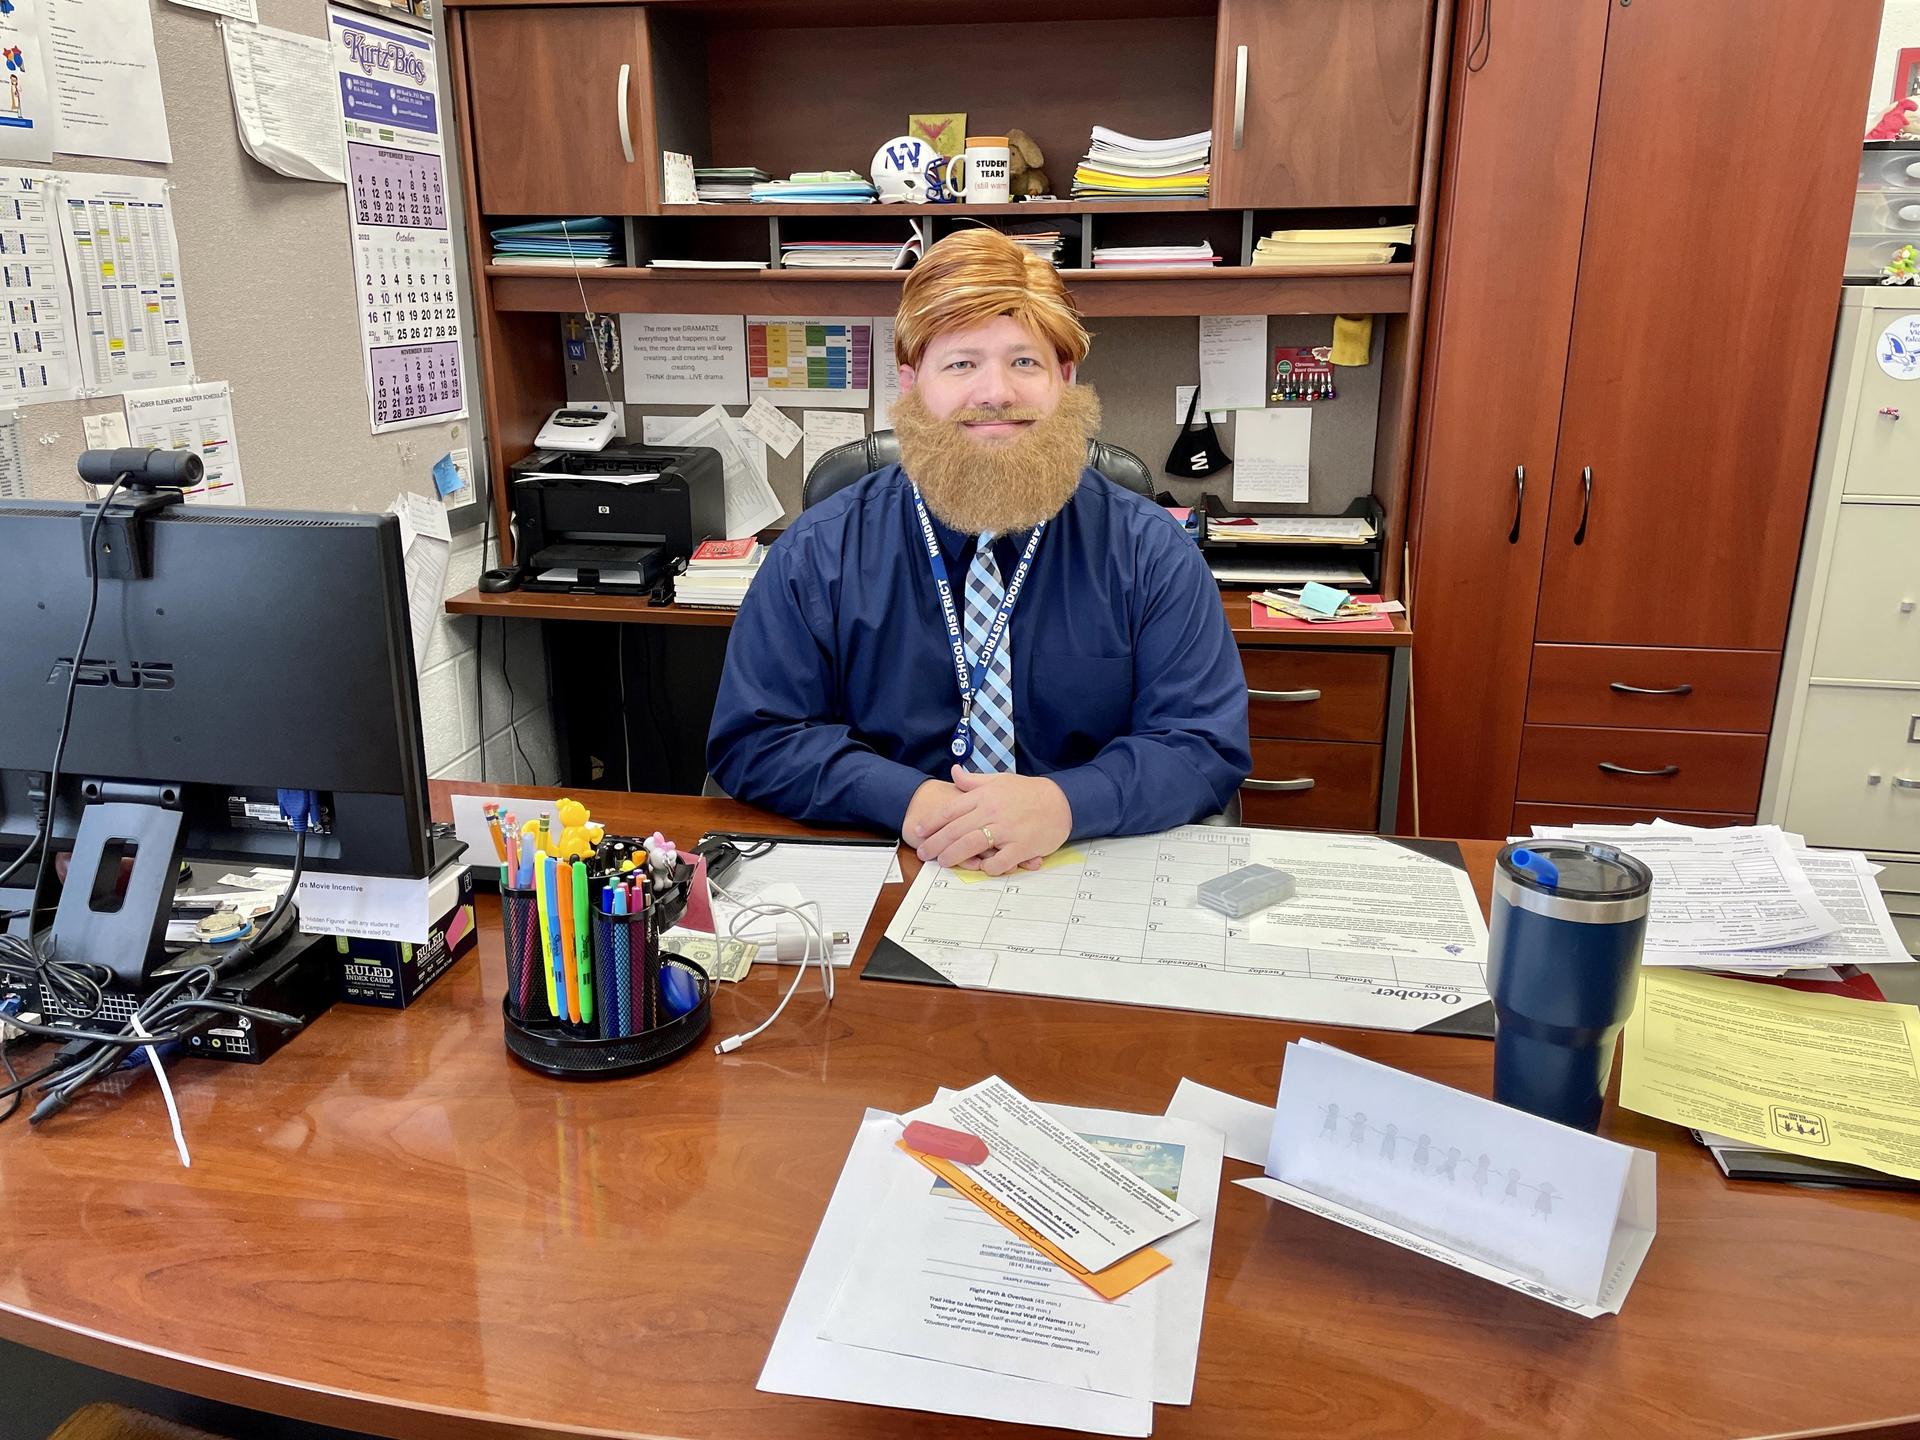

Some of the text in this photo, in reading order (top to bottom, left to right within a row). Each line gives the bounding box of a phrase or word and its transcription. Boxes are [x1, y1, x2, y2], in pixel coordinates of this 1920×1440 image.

[343, 29, 389, 75] Kurtz
[378, 151, 403, 159] SEPTEMBER
[887, 142, 921, 171] W
[976, 160, 1007, 168] STUDENT
[396, 232, 415, 243] October
[444, 257, 447, 267] 1
[366, 274, 450, 286] 2 3 4 5 6 7 8
[368, 292, 453, 304] 9 10 11 12 13 14 15
[368, 308, 455, 323] 16 17 18 19 20 21 22
[397, 326, 457, 340] 25 26 27 28 29
[156, 398, 184, 406] ELEMENTARY
[203, 392, 224, 400] SCHEDULE
[1190, 451, 1208, 470] W
[917, 501, 940, 558] WINDBER
[979, 527, 1041, 668] AREA SCHOOL DISTRICT
[938, 579, 960, 636] DISTRICT
[953, 641, 969, 689] SCHOOL
[47, 657, 176, 690] ASUS
[332, 884, 364, 892] Incentive
[1153, 898, 1168, 906] 12
[416, 930, 444, 961] RULED
[923, 938, 961, 946] Saturday
[1080, 952, 1120, 960] Thursday
[1157, 958, 1208, 968] Wednesday
[344, 964, 393, 978] RULED
[1248, 968, 1286, 976] Tuesday
[1334, 974, 1373, 984] Monday
[1424, 983, 1461, 992] Sunday
[1372, 986, 1462, 1004] October
[1007, 1293, 1033, 1302] Overlook
[956, 1308, 975, 1316] Voices
[964, 1302, 992, 1311] Memorial
